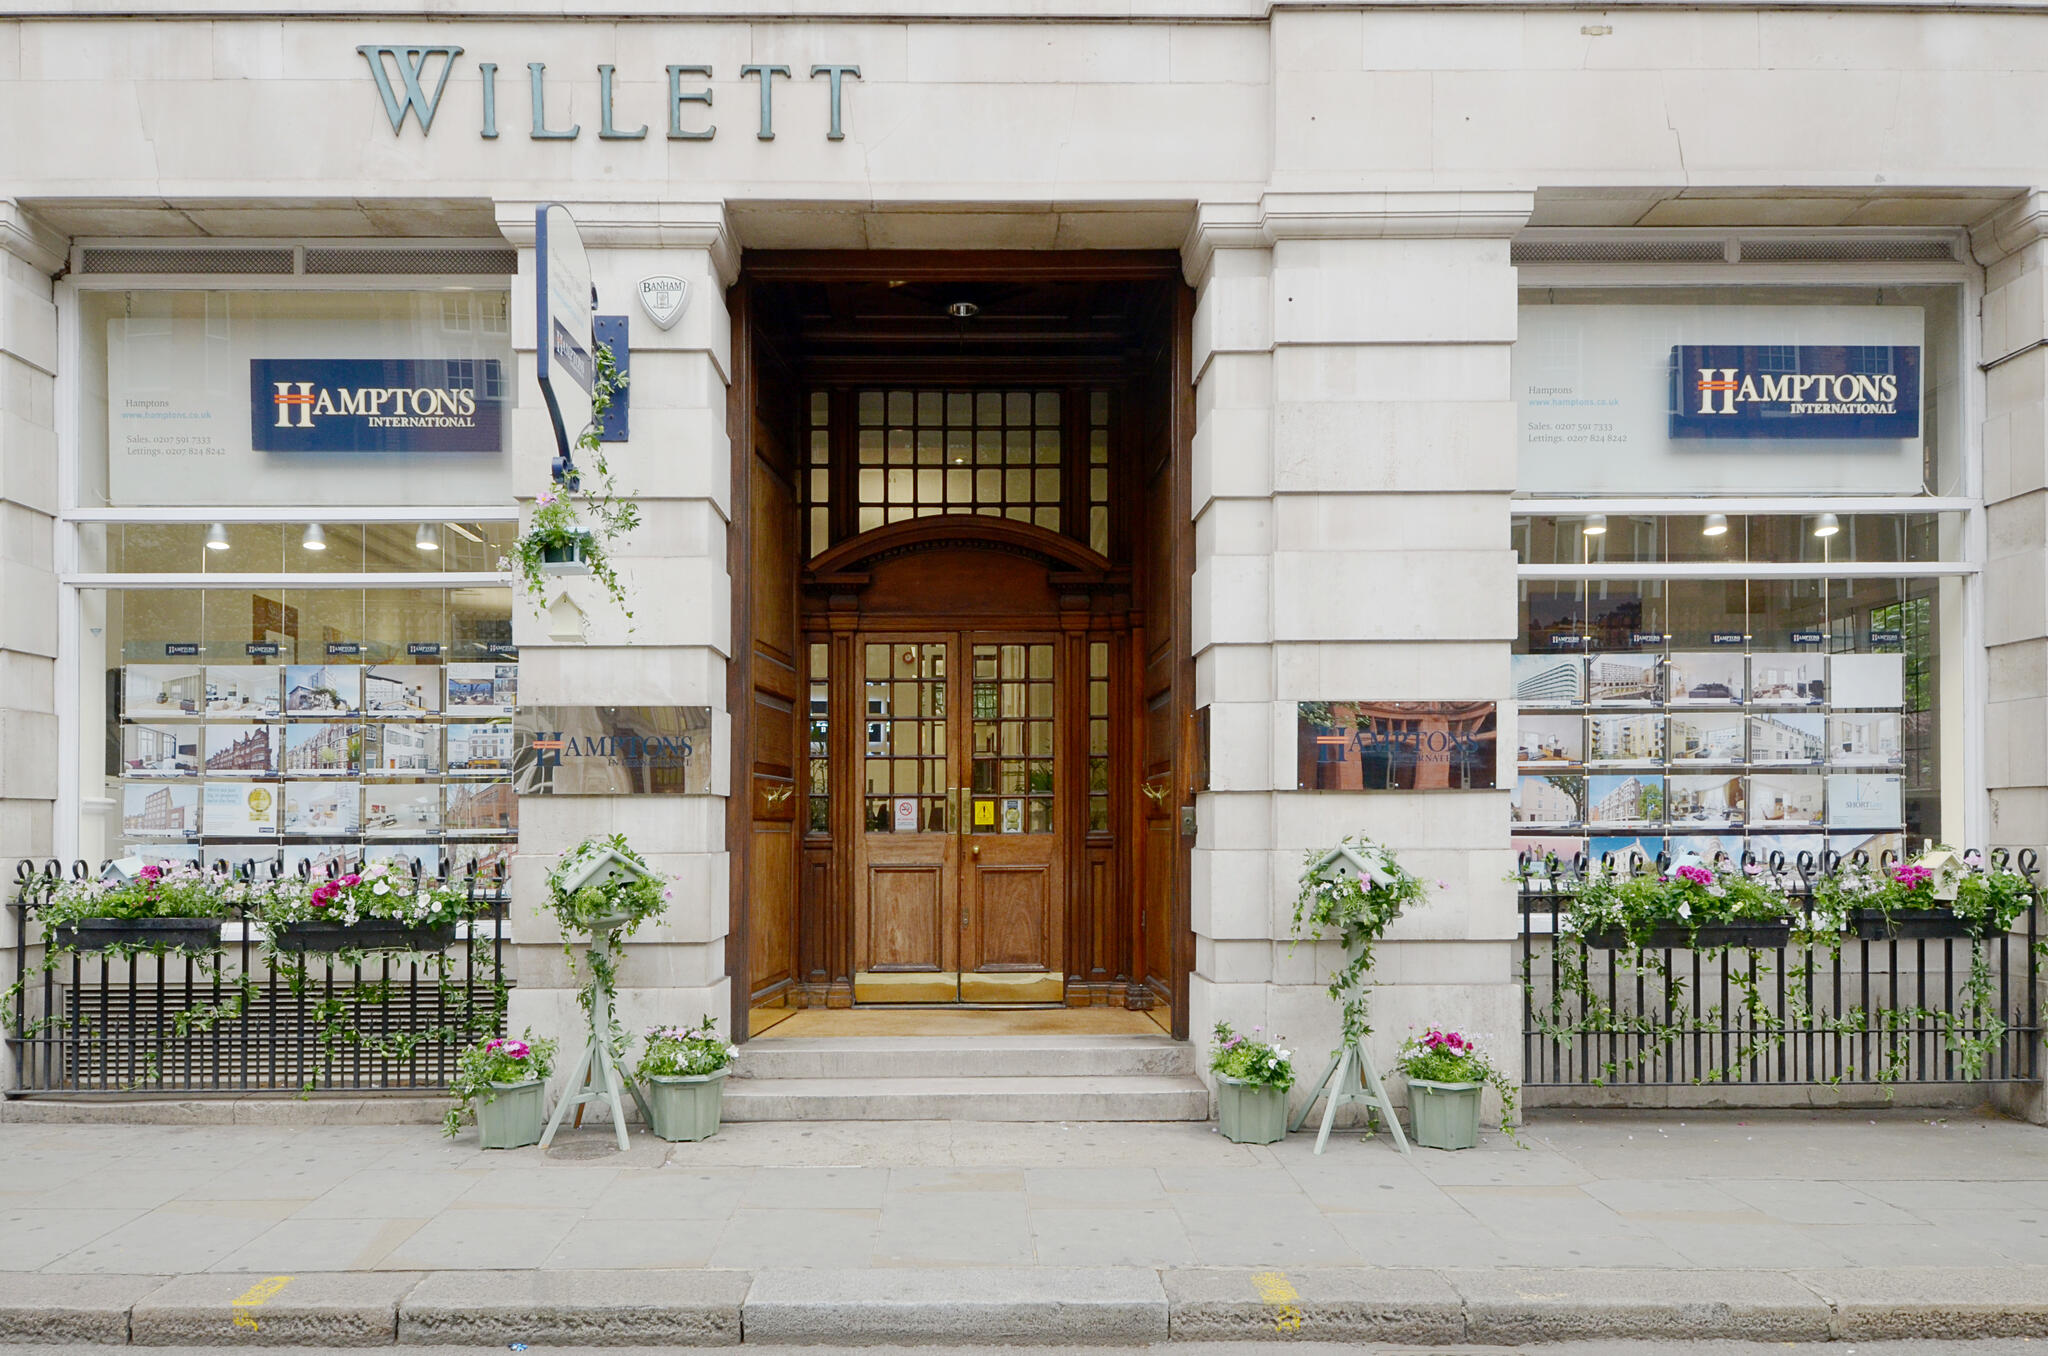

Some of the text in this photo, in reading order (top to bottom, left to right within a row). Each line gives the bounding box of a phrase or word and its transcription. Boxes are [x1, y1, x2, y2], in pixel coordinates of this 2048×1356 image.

[355, 44, 862, 141] WILLETT
[643, 281, 682, 292] BANHAM
[1528, 385, 1573, 395] Hamptons
[1697, 368, 1898, 414] HAMPTONS
[125, 399, 169, 409] Hamptons
[273, 382, 476, 427] HAMPTONS
[1528, 397, 1619, 407] www.hamptons.co.uk
[1790, 403, 1896, 414] INTERNATIONAL
[121, 411, 212, 420] www.hamptons.co.uk
[368, 417, 475, 427] INTERNATIONAL
[1555, 423, 1575, 431] 0207
[1578, 423, 1592, 431] 591
[1594, 423, 1613, 431] 7333
[153, 436, 174, 445] 0207
[1567, 434, 1588, 443] 0207
[1590, 434, 1605, 443] 824
[1607, 434, 1628, 443] 8242
[165, 448, 187, 457] 0207
[1317, 726, 1479, 762] HAMPTONS
[533, 732, 693, 767] HAMPTONS
